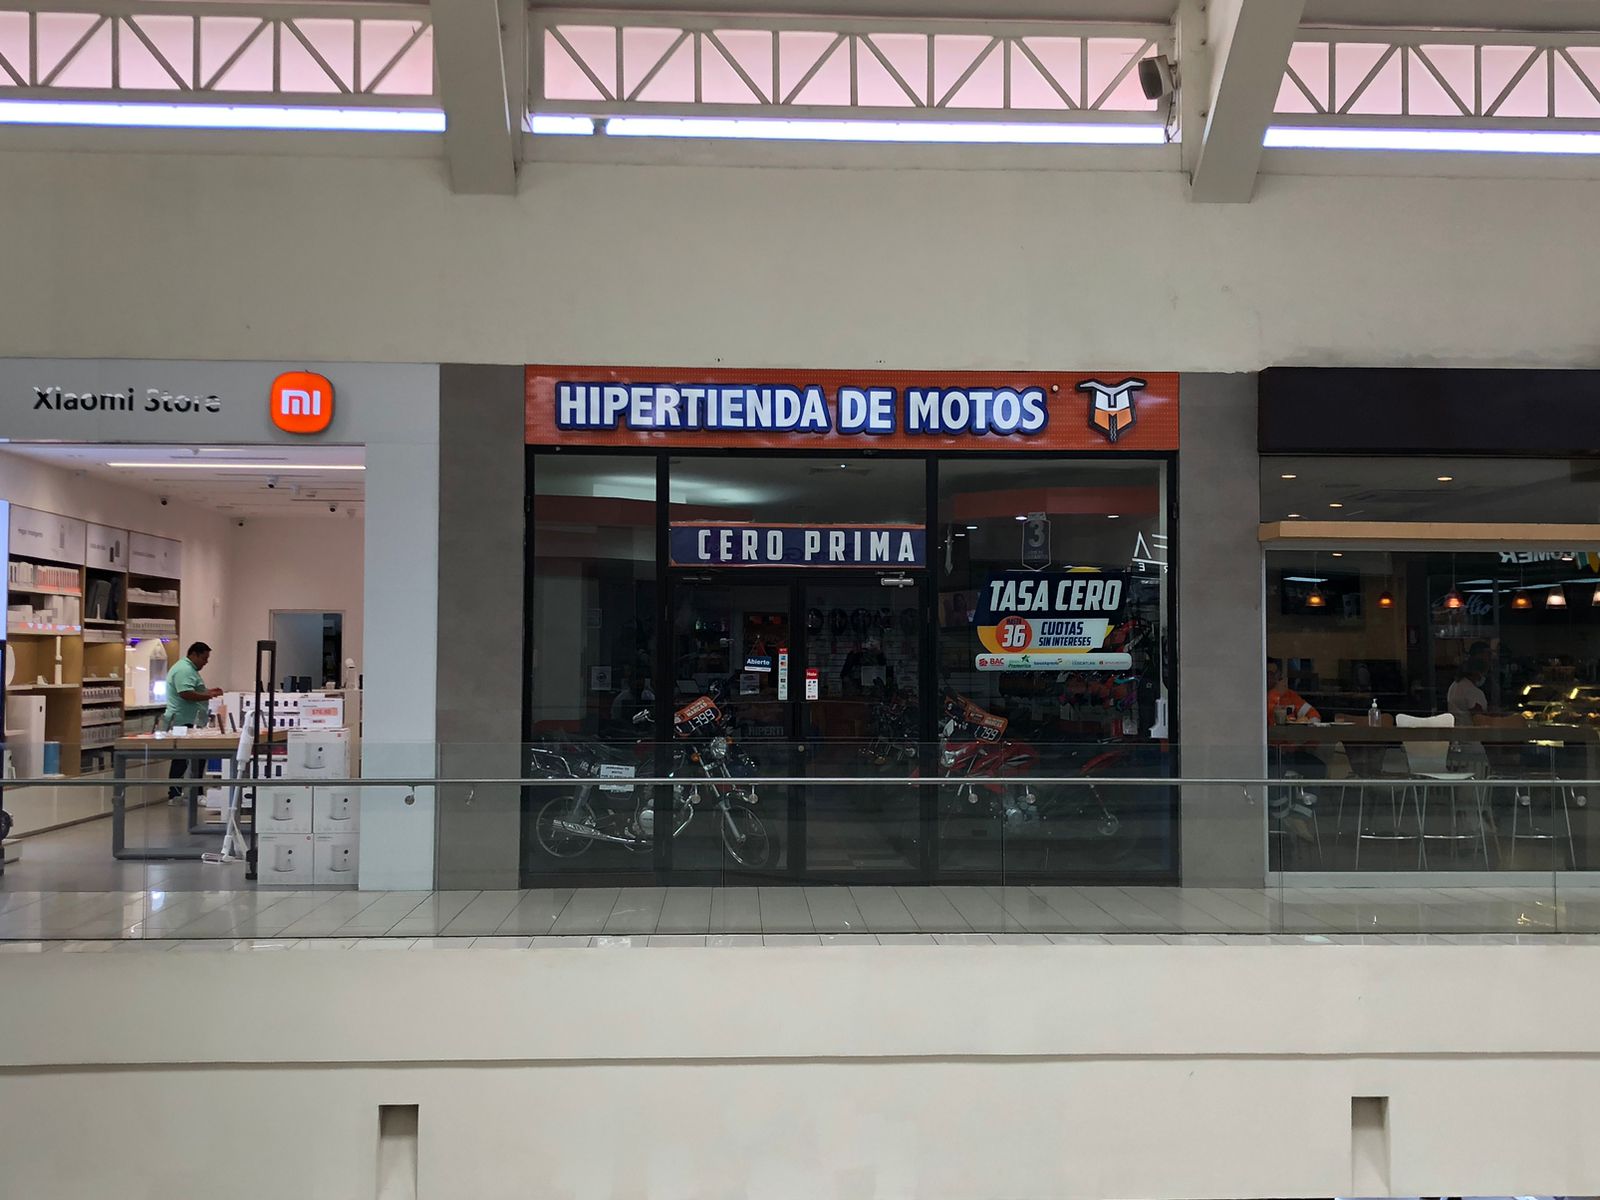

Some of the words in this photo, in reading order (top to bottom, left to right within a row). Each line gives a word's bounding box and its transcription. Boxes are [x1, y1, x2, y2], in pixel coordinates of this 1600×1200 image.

[33, 387, 134, 411] Xiaomi
[144, 388, 221, 413] Store
[559, 385, 827, 429] HIPERTIENDA
[841, 387, 893, 429] DE
[909, 390, 1046, 431] MOTOS
[697, 530, 784, 562] CERO
[804, 530, 915, 563] PRIMA
[990, 580, 1049, 612] TASA
[1055, 580, 1122, 611] CERO
[1002, 624, 1026, 647] 36
[1041, 621, 1084, 636] CUOTAS
[1038, 636, 1051, 647] SIN
[1051, 636, 1091, 647] INTERESES
[746, 658, 770, 666] Abierto
[989, 657, 1005, 665] BAC
